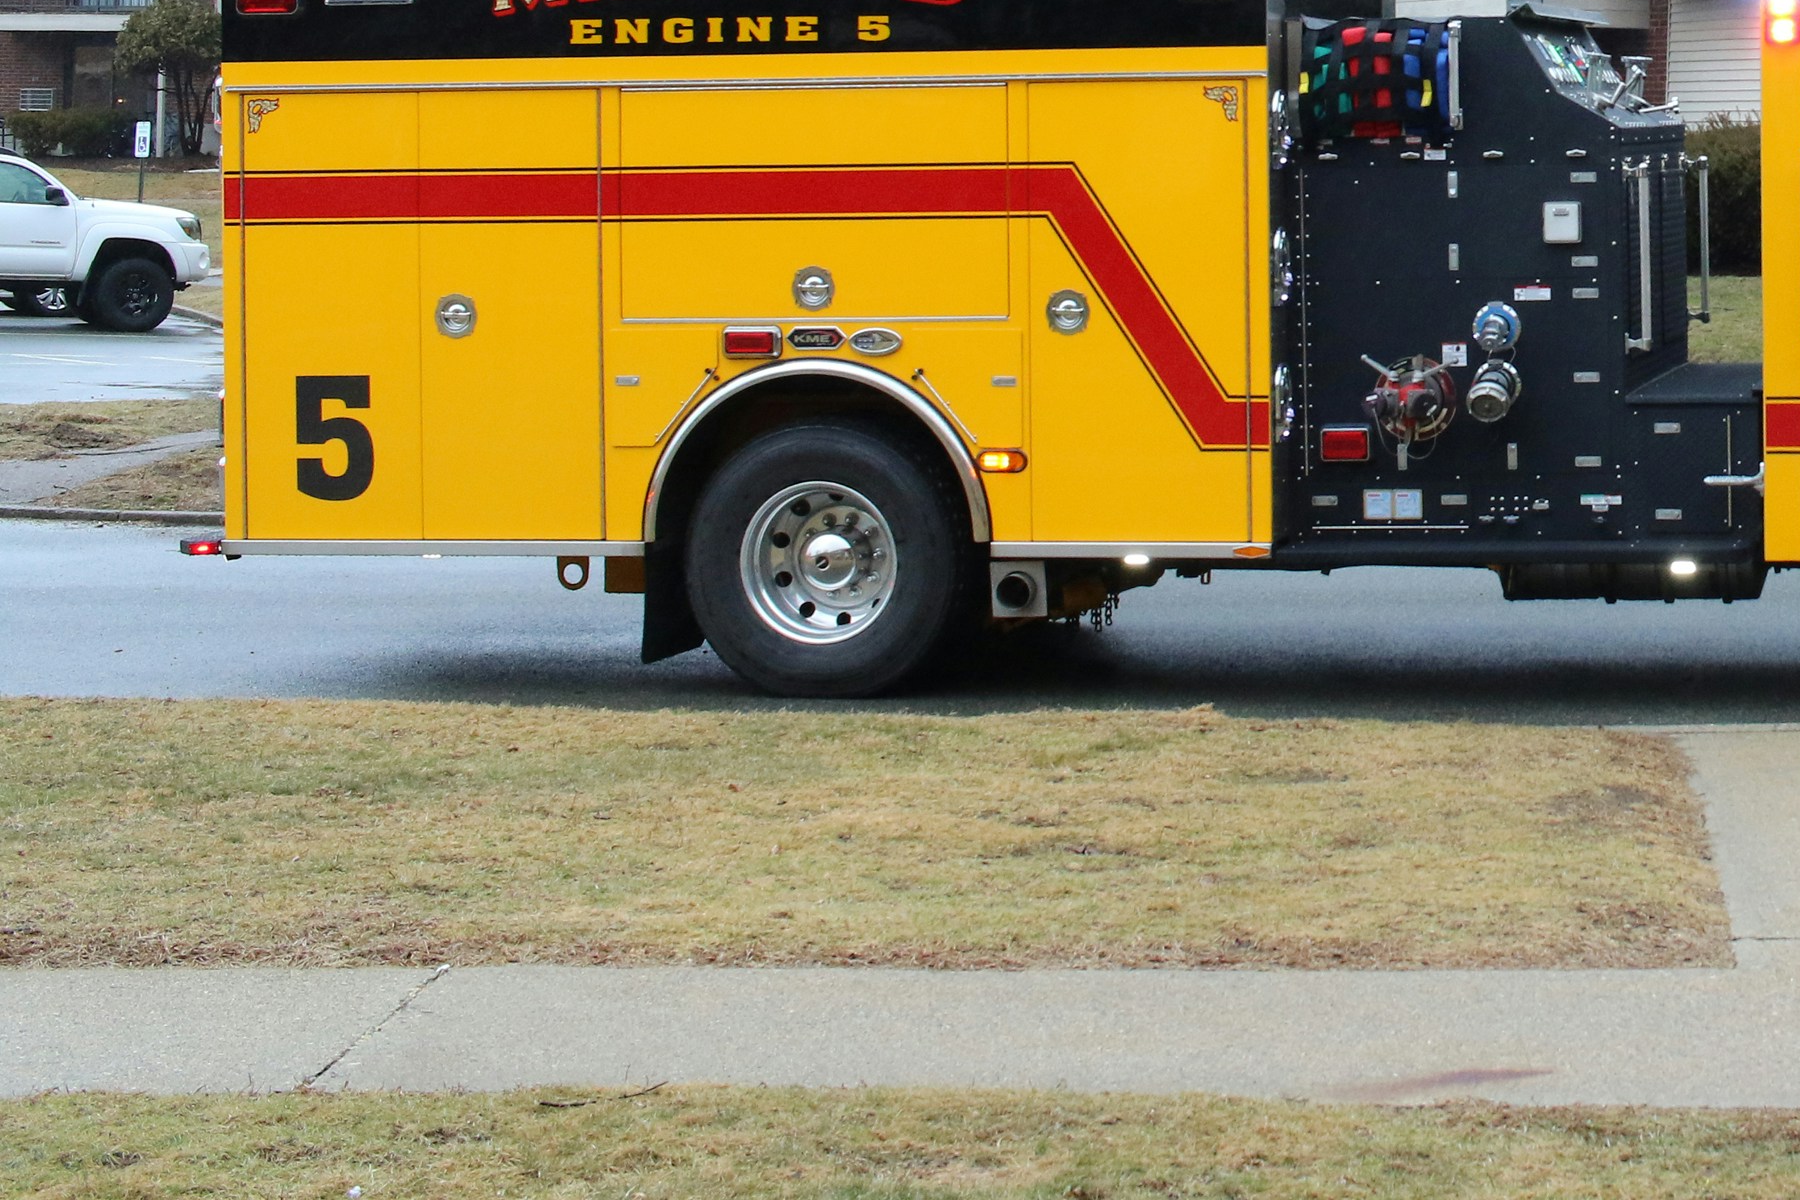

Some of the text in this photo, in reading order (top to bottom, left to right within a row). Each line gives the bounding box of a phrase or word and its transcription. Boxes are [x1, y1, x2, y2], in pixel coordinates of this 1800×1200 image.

[569, 14, 892, 45] ENGINE 5
[794, 334, 831, 343] KME
[295, 375, 375, 501] 5
